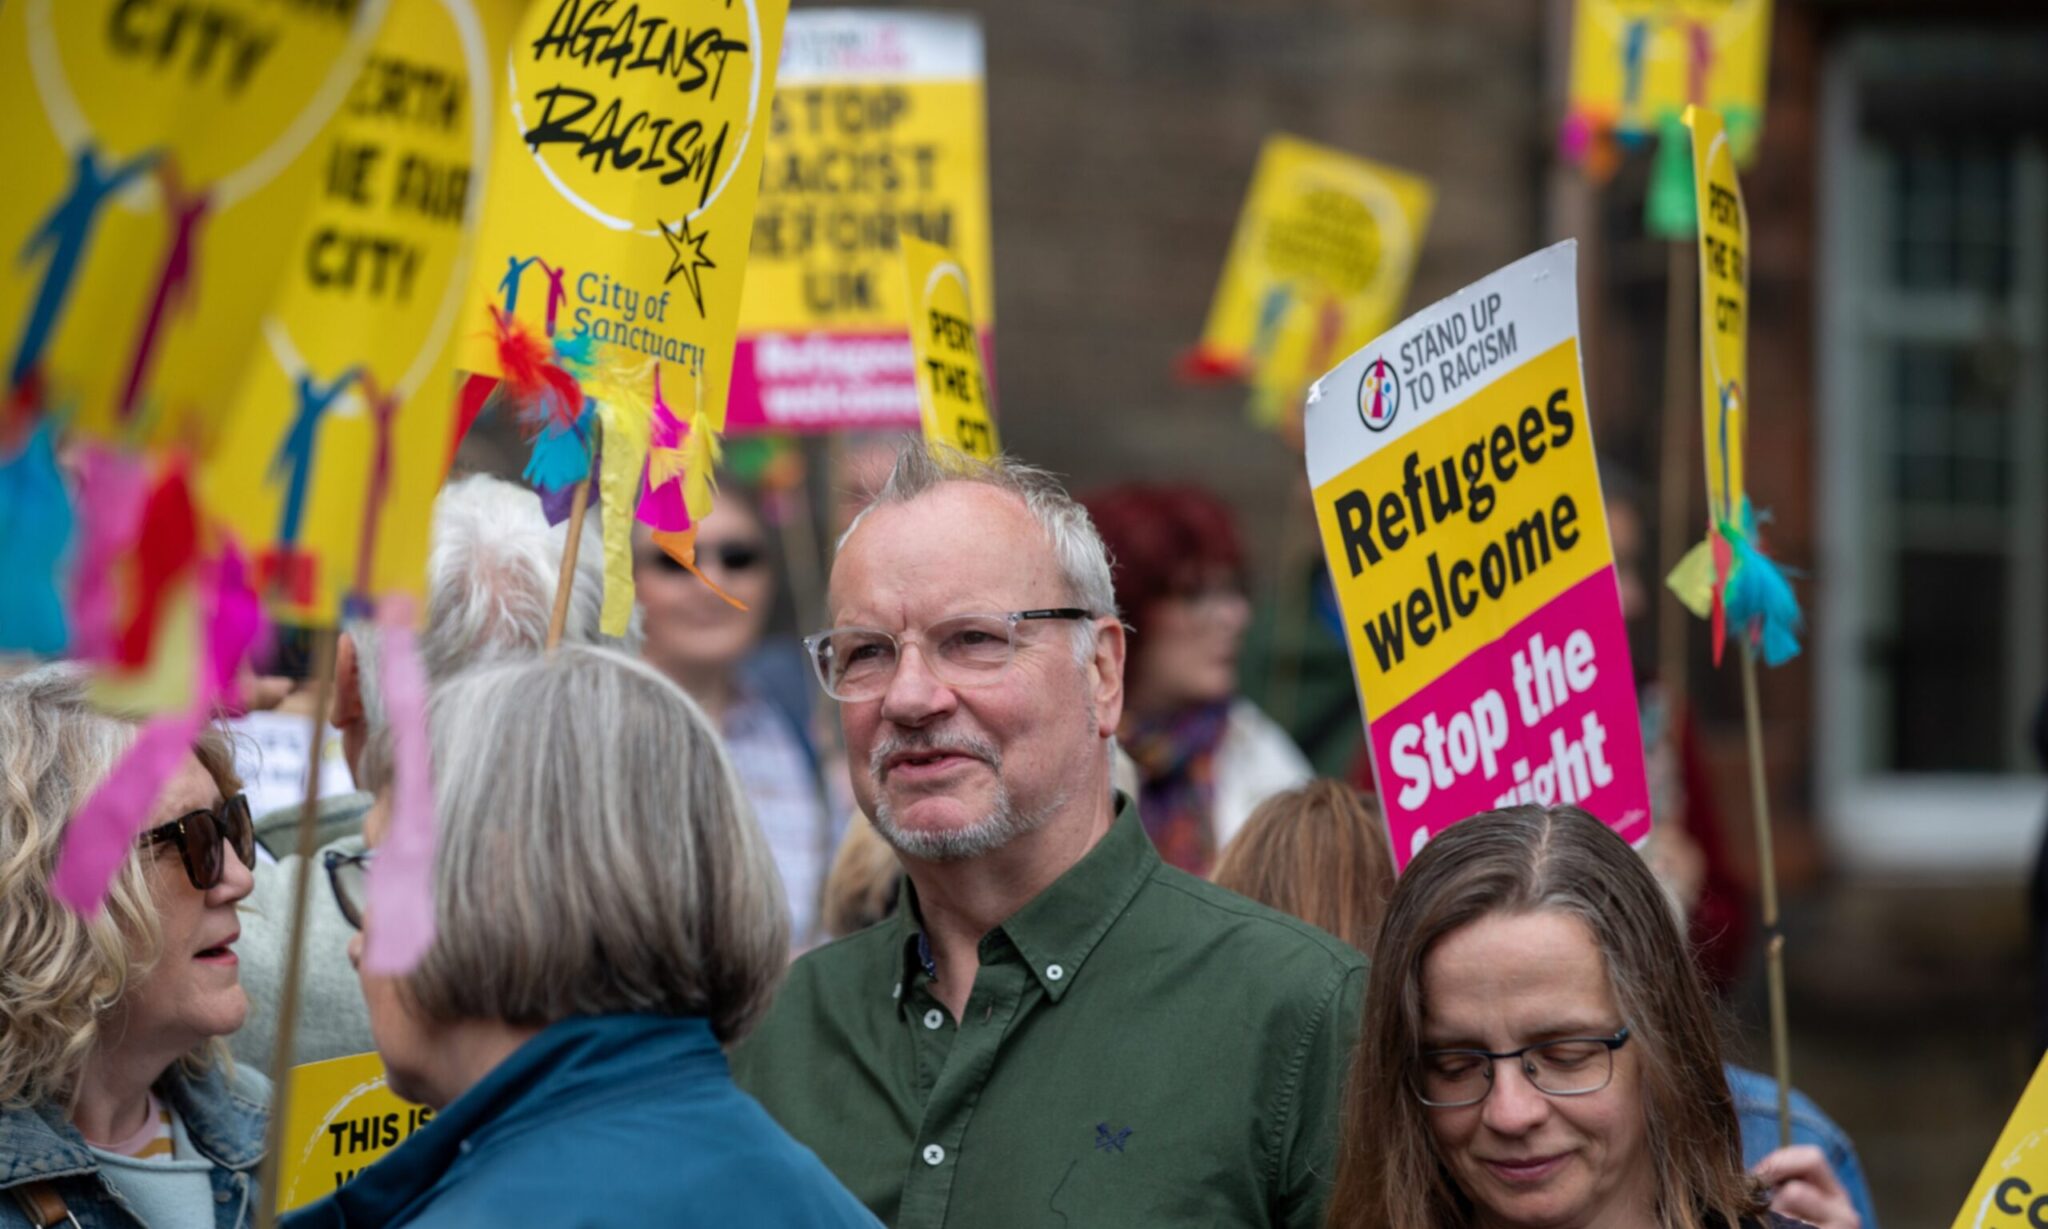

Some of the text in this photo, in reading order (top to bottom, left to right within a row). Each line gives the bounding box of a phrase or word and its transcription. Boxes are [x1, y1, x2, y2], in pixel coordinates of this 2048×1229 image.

[532, 0, 748, 101] AGAINST
[524, 84, 729, 209] RACISM
[760, 146, 936, 192] ACIST
[571, 307, 706, 377] Sanctuary
[576, 272, 671, 323] City of
[1400, 292, 1502, 375] STAND UP
[1405, 321, 1518, 410] TO RACISM
[1334, 387, 1574, 579] Refugees
[1363, 494, 1581, 674] welcome
[1390, 629, 1598, 811] Stop the
[328, 1112, 399, 1157] THIS
